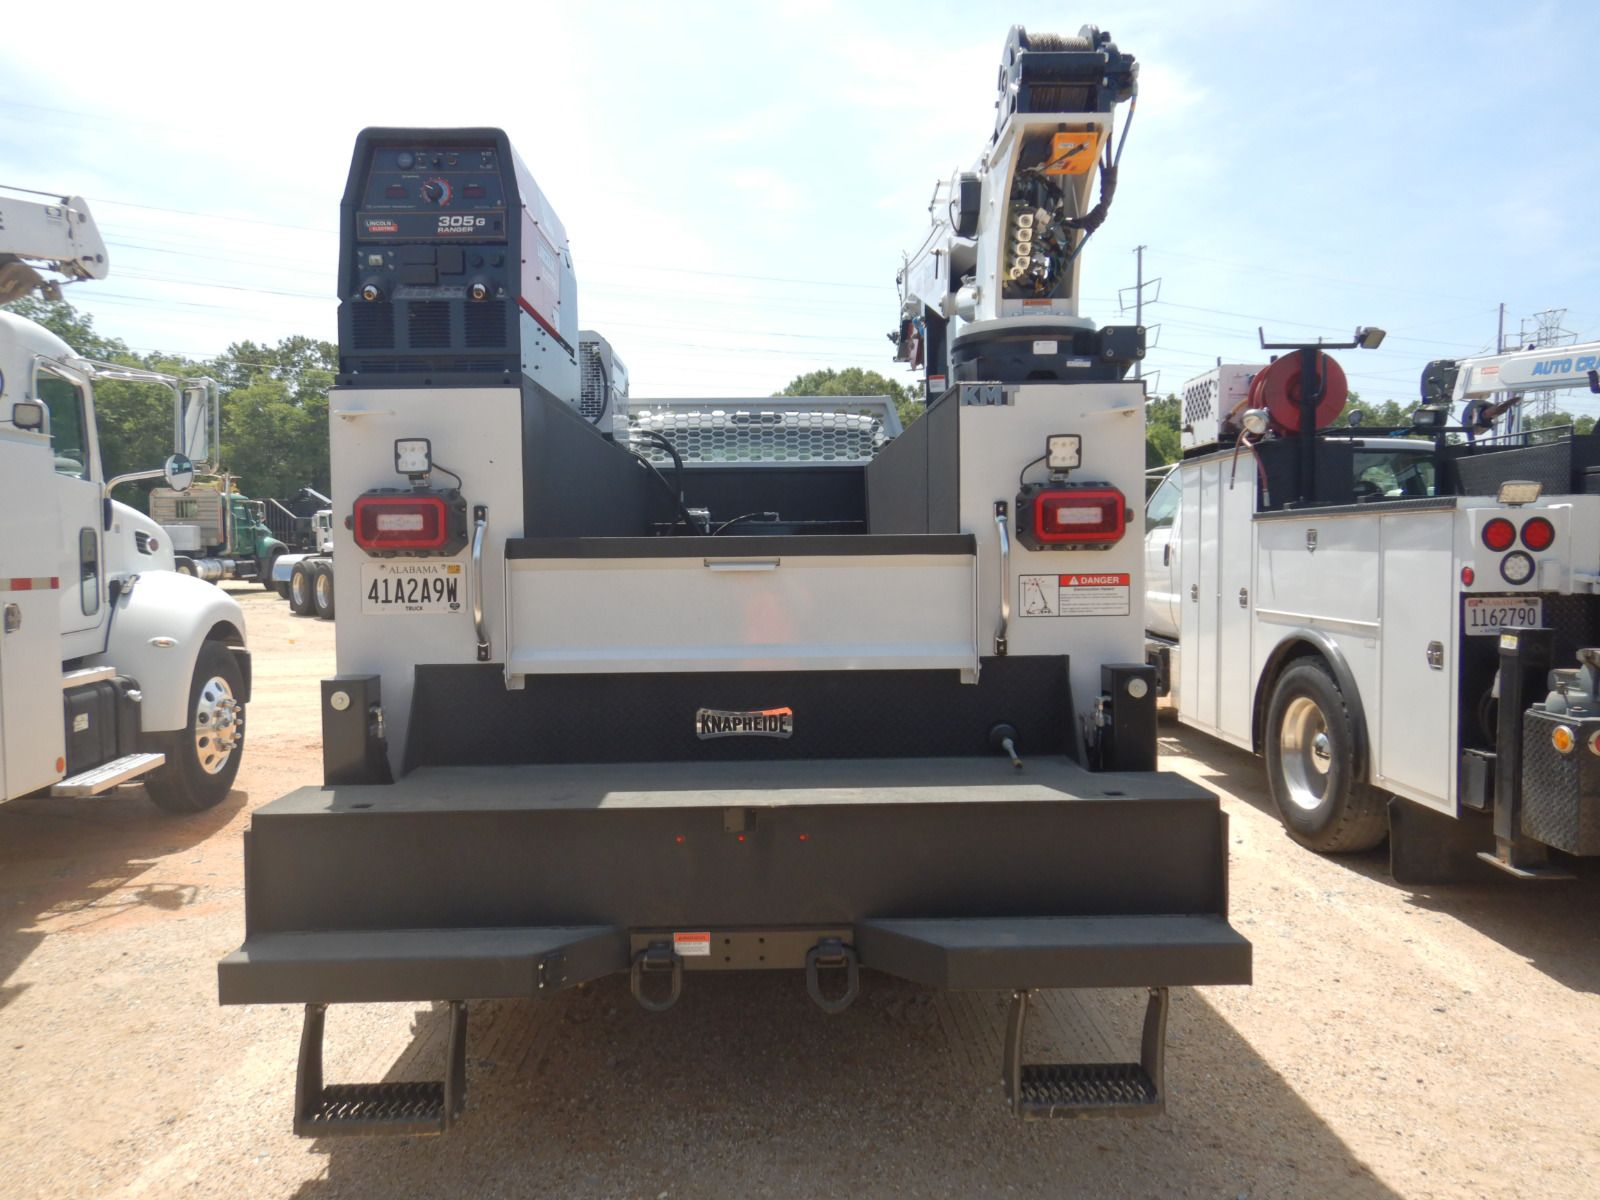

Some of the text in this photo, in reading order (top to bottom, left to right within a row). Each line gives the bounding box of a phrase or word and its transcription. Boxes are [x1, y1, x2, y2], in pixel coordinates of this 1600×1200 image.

[1532, 355, 1600, 376] AUTO CR
[389, 565, 438, 574] ALABAMA
[1080, 576, 1120, 585] DANGER
[368, 578, 458, 604] 41A2A9W
[1471, 607, 1536, 627] 1162790
[700, 712, 789, 734] KNAPHEIDE
